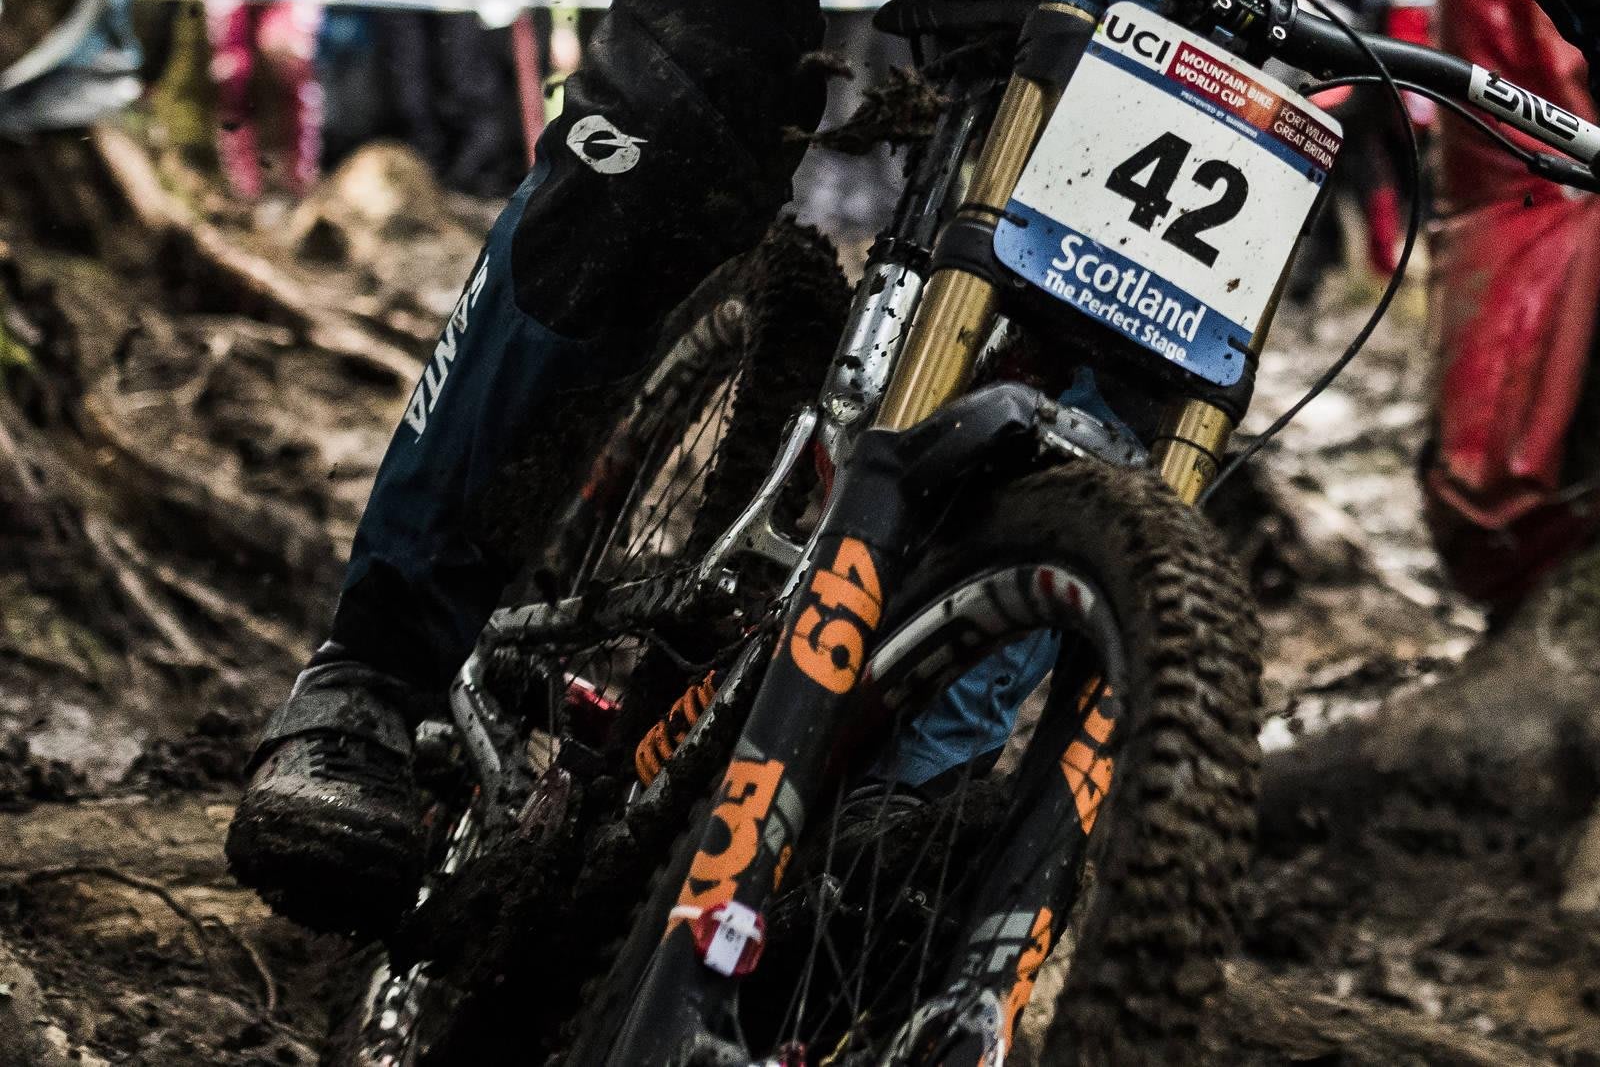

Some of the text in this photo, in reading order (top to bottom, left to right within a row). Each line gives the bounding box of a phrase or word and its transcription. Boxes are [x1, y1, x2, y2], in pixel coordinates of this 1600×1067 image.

[1105, 14, 1172, 66] UCI
[1174, 63, 1246, 108] WORLD CUP
[1180, 49, 1275, 111] MOUNTAIN BIKE
[1273, 120, 1335, 169] GREAT BRITAIN
[1279, 105, 1341, 155] FORT WILLIAM
[1105, 131, 1249, 269] 42
[1044, 268, 1187, 362] The Perfect Stage
[1051, 234, 1207, 343] Scotland
[404, 253, 490, 441] SANTA
[790, 536, 884, 694] 49
